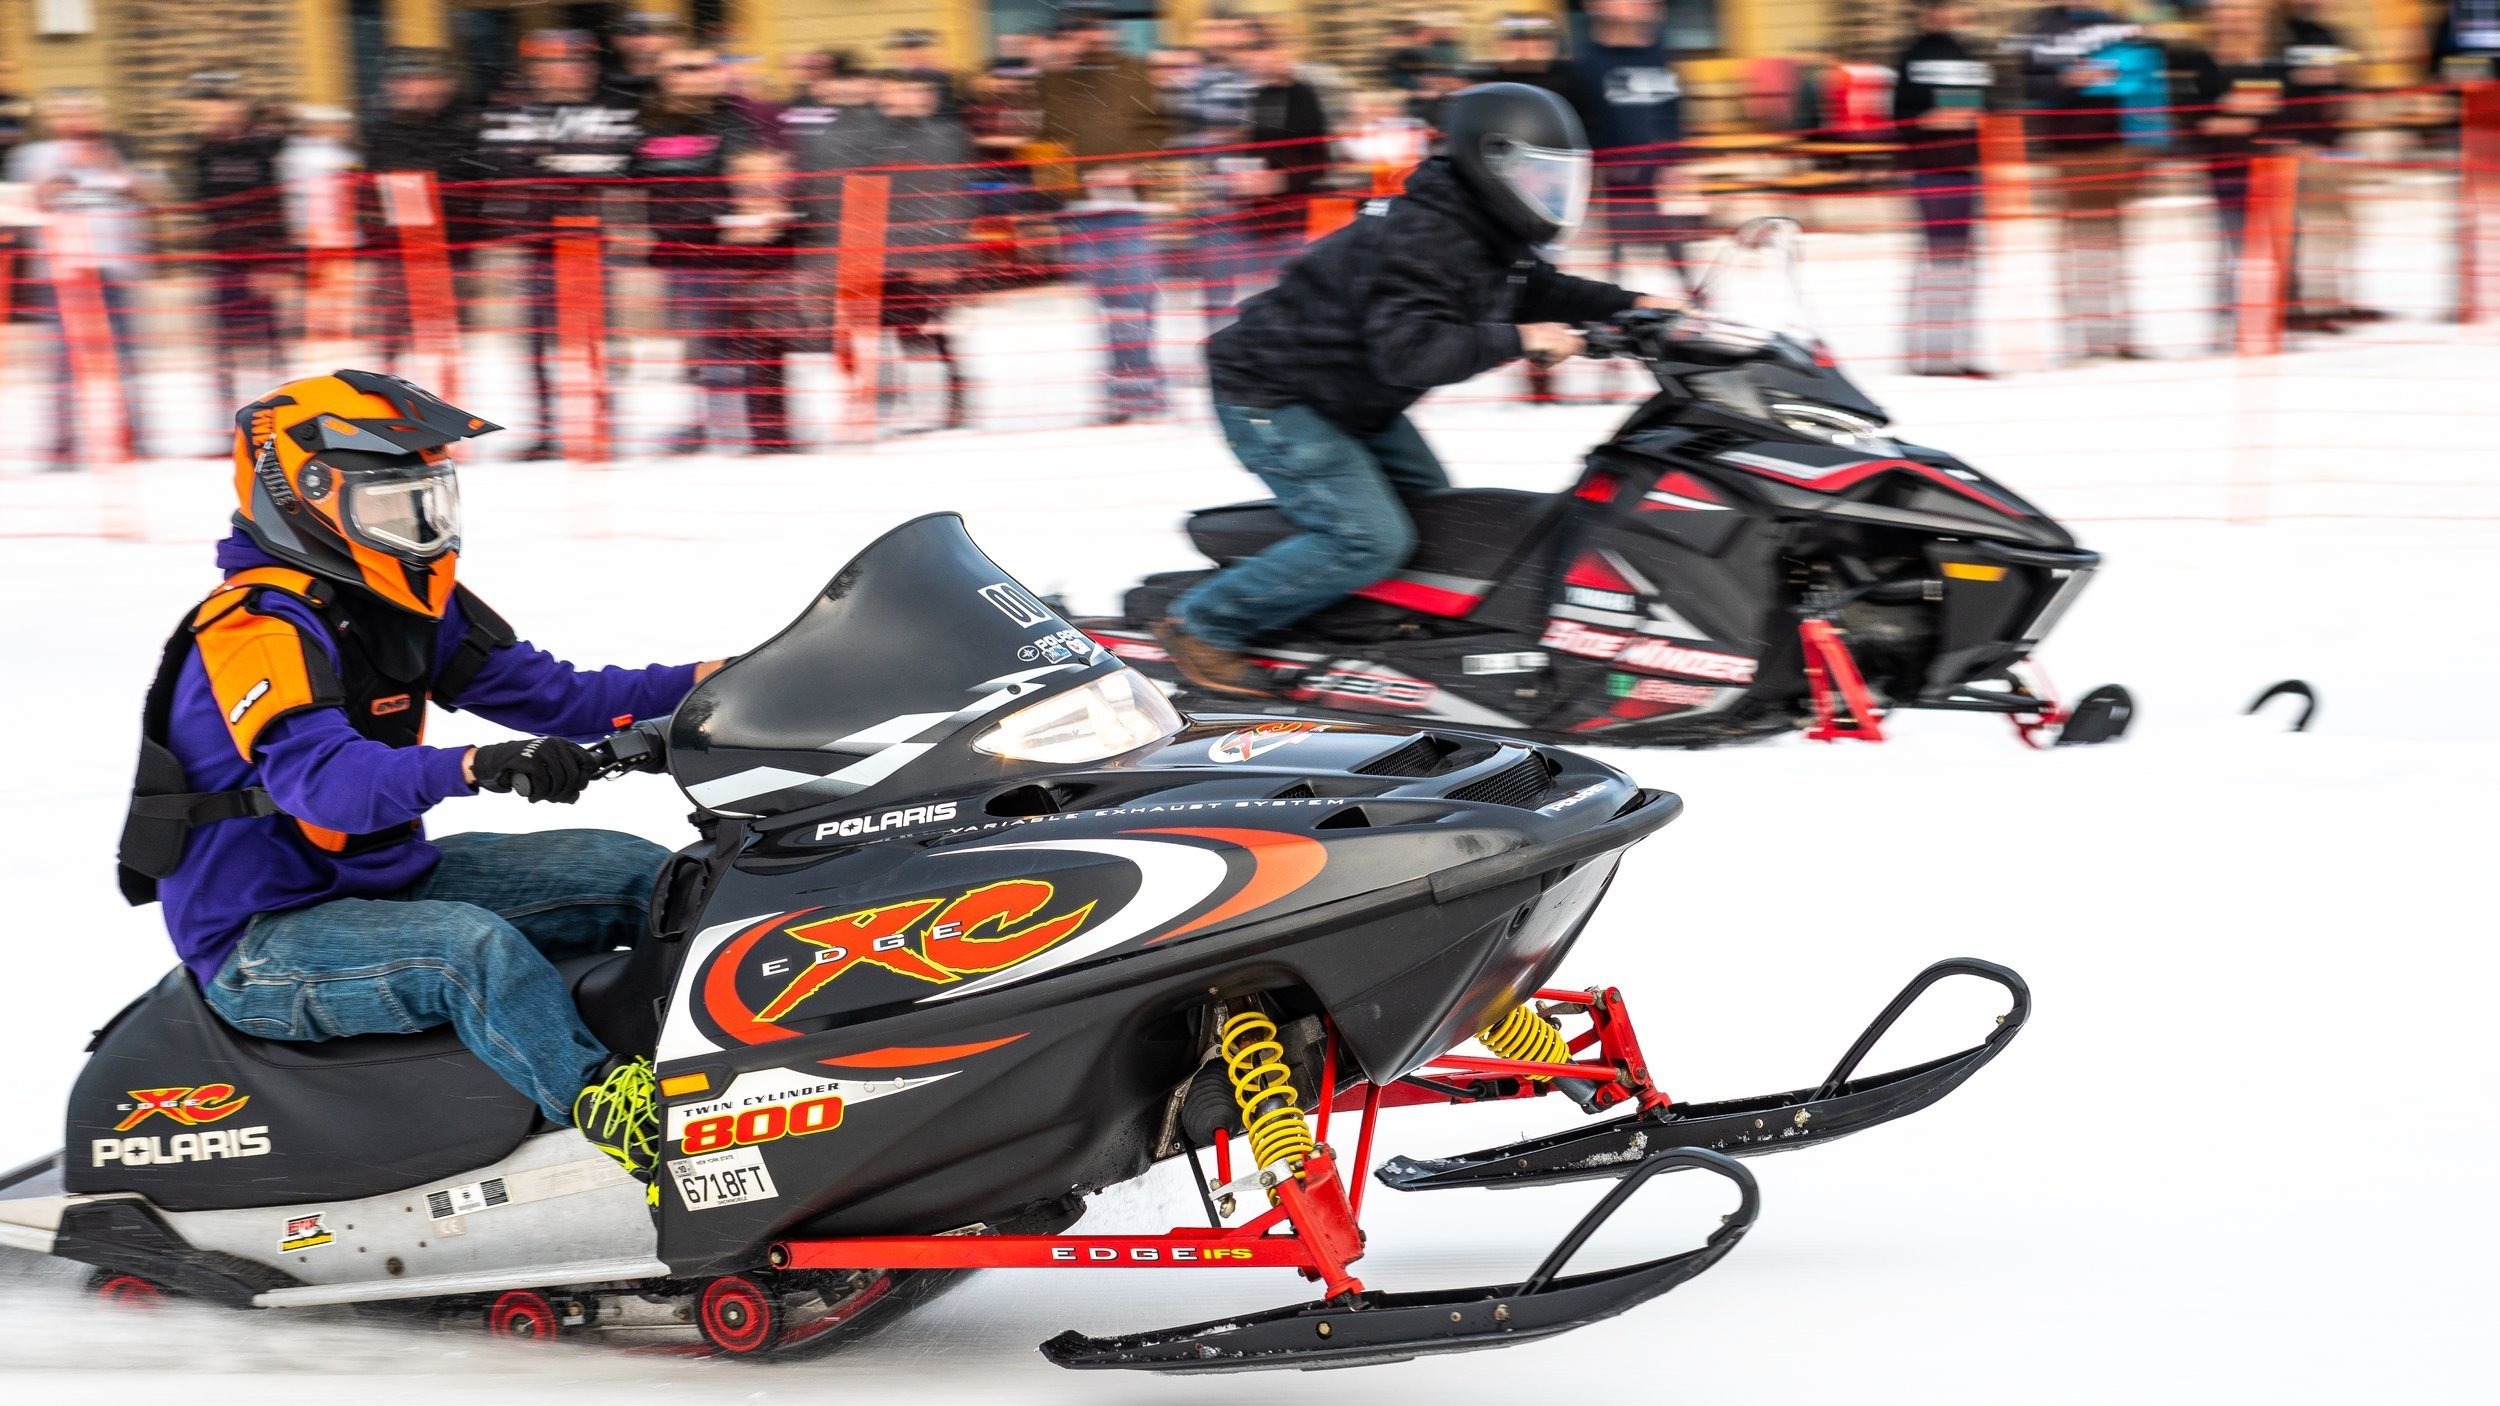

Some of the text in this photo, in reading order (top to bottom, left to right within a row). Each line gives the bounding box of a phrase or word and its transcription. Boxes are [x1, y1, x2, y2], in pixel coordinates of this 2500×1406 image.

[815, 801, 958, 841] POLARIS
[950, 799, 1345, 834] VARIABLE EXHAUST SYSTEM
[752, 879, 1099, 1023] XC
[762, 920, 964, 977] EDGE
[113, 1083, 251, 1132] XC
[116, 1098, 201, 1111] EDGE
[683, 1082, 840, 1117] TWIN CYLINDER
[681, 1096, 844, 1155] 800
[91, 1125, 272, 1168] POLARIS
[682, 1166, 765, 1204] 6718FT
[1051, 1247, 1253, 1261] EDGE IFS
